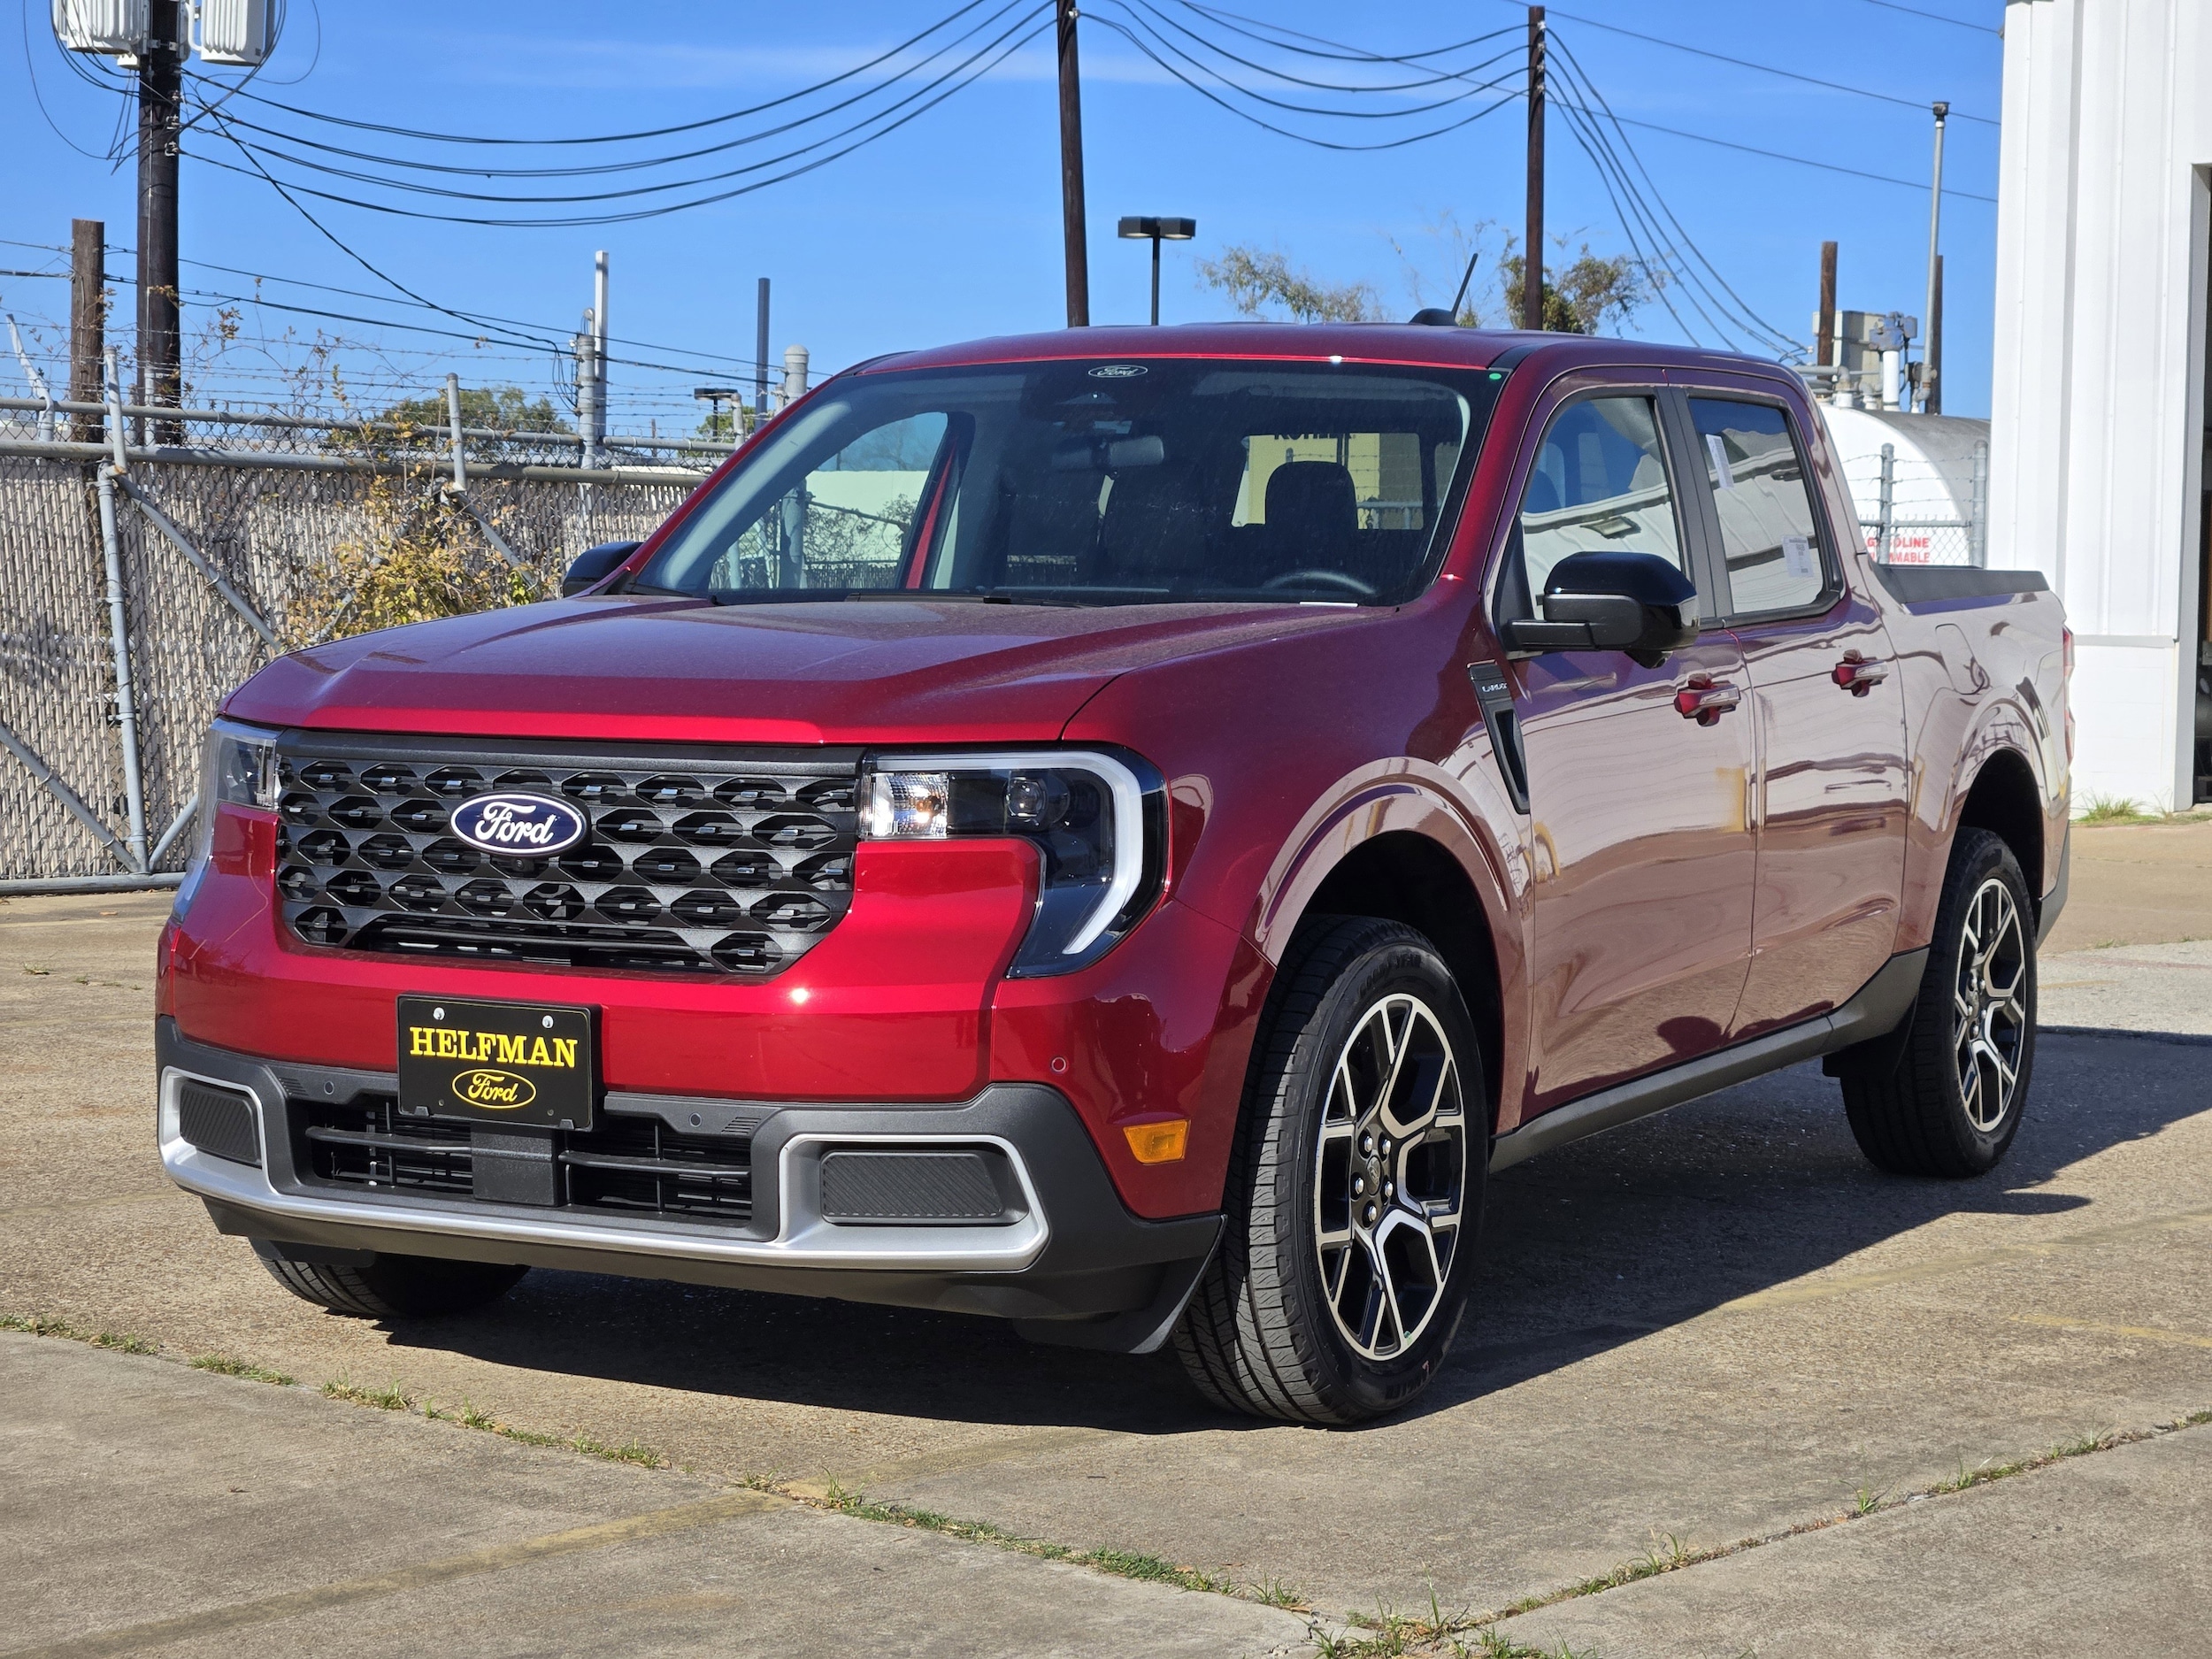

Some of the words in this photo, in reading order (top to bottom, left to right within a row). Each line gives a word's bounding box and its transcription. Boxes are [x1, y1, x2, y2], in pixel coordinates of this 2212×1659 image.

[1097, 366, 1139, 376] Ford
[1867, 536, 1930, 548] GOLINE
[474, 802, 557, 844] Ford
[409, 1026, 578, 1069] HELFMAN
[467, 1072, 519, 1102] Ford
